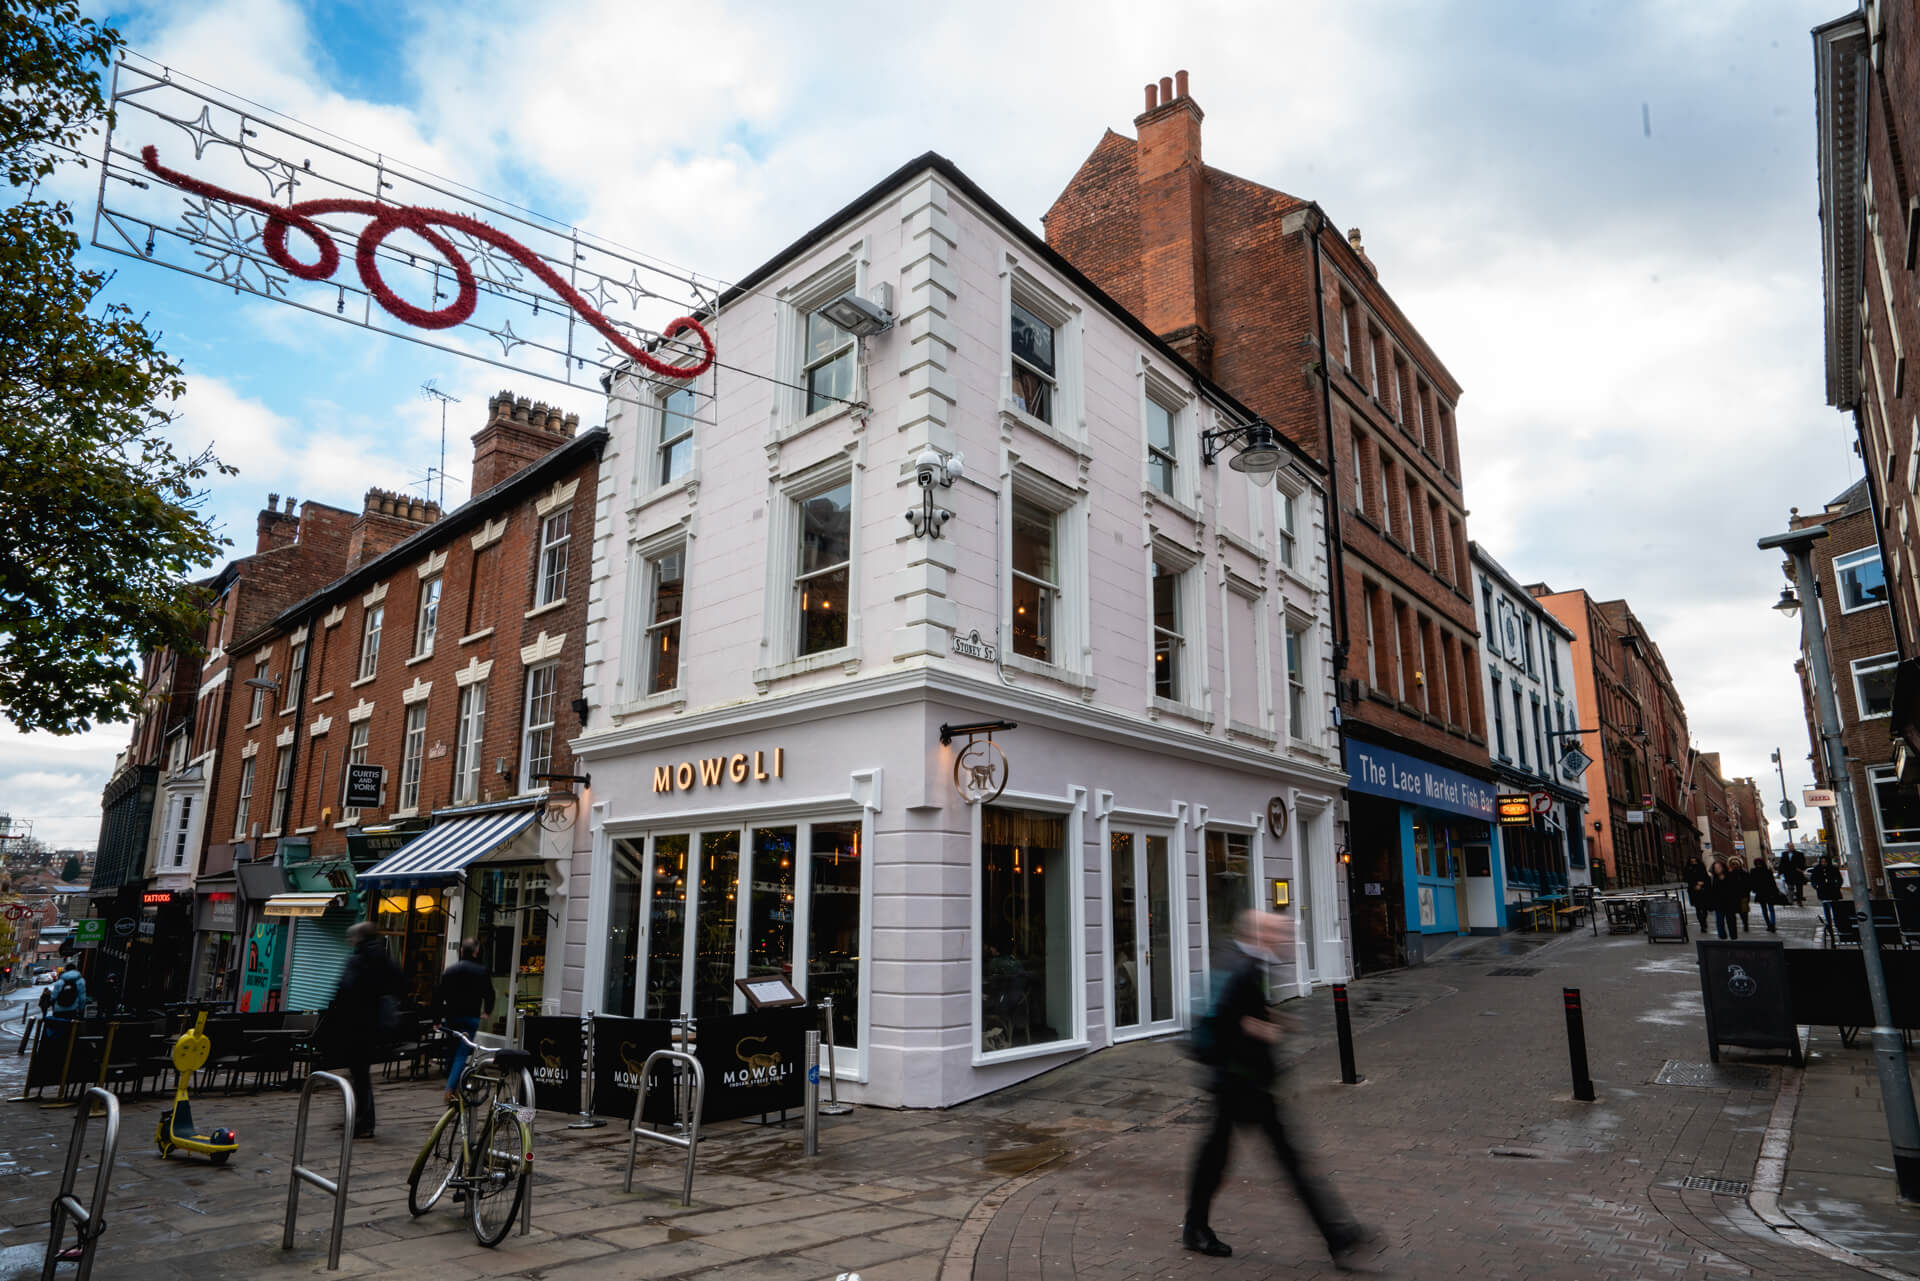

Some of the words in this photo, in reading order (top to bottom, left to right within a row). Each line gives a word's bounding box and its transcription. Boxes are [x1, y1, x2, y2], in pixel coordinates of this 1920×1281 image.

[956, 638, 981, 657] STONEY
[352, 769, 380, 779] CURTIS
[652, 747, 784, 793] MOWGLI
[353, 783, 376, 791] YORK
[1359, 754, 1387, 786] The
[1391, 762, 1421, 794] Lace
[1424, 772, 1459, 804] Market
[1461, 783, 1479, 809] Fish
[1480, 789, 1493, 813] Bar
[143, 893, 171, 904] TATTOOS
[533, 1066, 569, 1081] MOWGLI
[723, 1062, 793, 1084] MOWGLI
[750, 1077, 768, 1085] STREET
